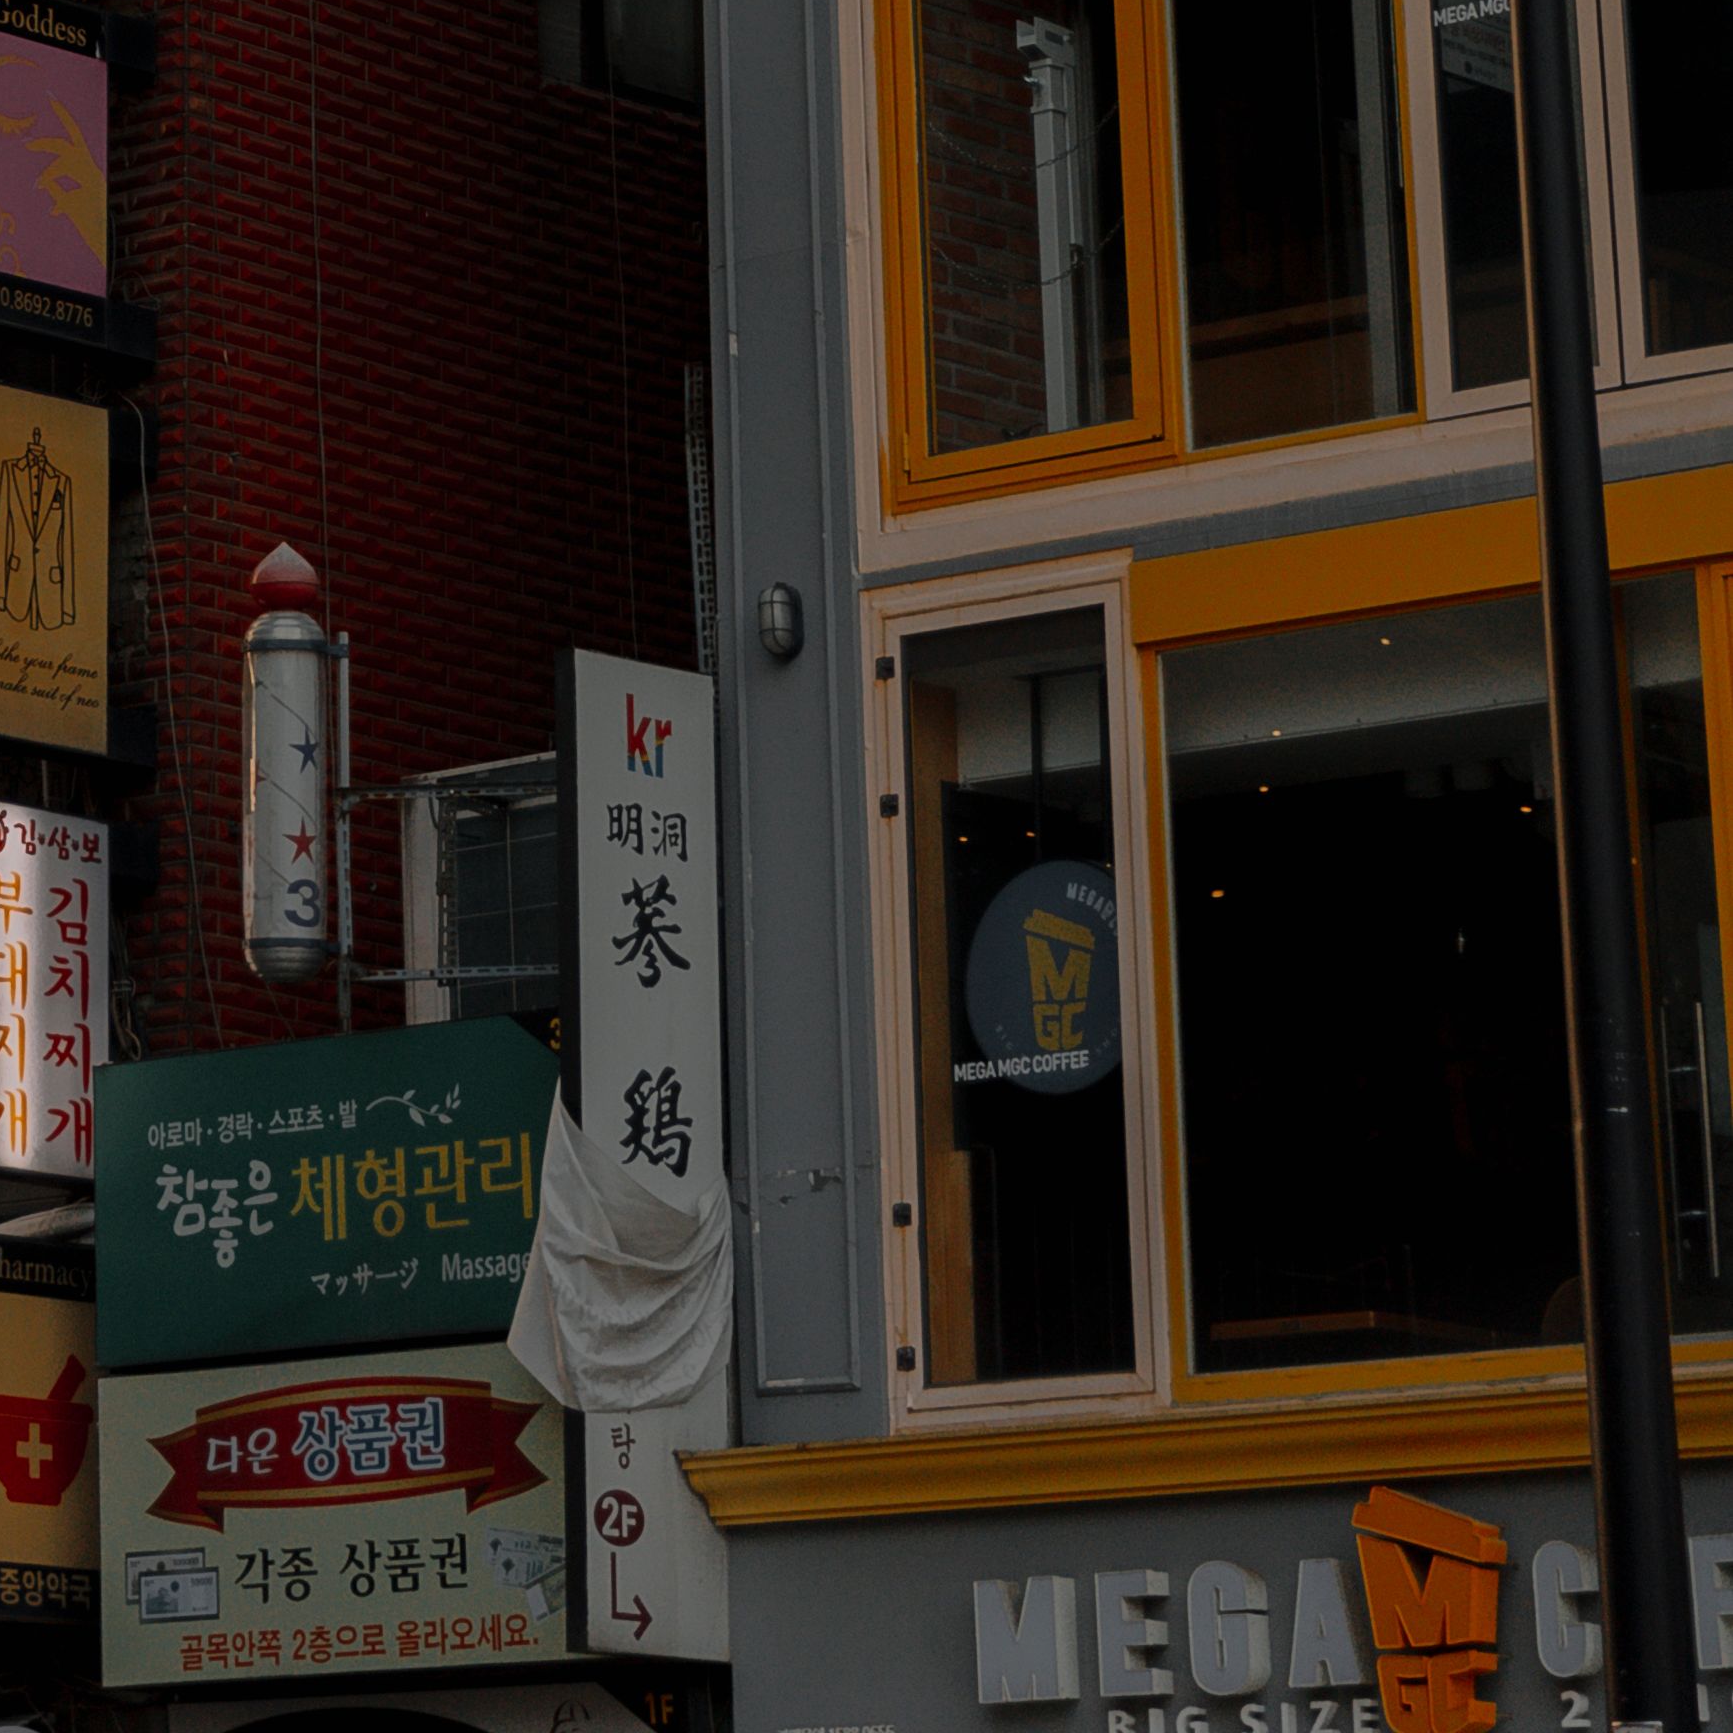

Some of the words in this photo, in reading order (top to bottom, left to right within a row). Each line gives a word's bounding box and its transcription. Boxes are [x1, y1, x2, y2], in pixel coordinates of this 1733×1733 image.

[1434, 2, 1479, 27] MEGA
[606, 802, 688, 862] 明洞
[43, 878, 93, 1167] 김치찌개
[954, 1060, 996, 1083] MEGA
[998, 1056, 1031, 1076] MGC
[1032, 1049, 1090, 1073] COFFEE
[155, 1159, 279, 1269] 참좋은
[290, 1131, 533, 1242] 체형관리
[311, 1258, 419, 1297] マッサージ
[441, 1250, 531, 1285] Massage
[206, 1427, 280, 1475] 다온
[291, 1396, 446, 1482] 상품권
[601, 1495, 638, 1538] 2F
[234, 1546, 319, 1605] 각종
[339, 1532, 469, 1598] 상품권
[180, 1629, 283, 1671] 골목안쪽
[292, 1623, 386, 1664] 2층으로
[973, 1558, 1371, 1705] MEGA
[643, 1691, 676, 1728] 1F
